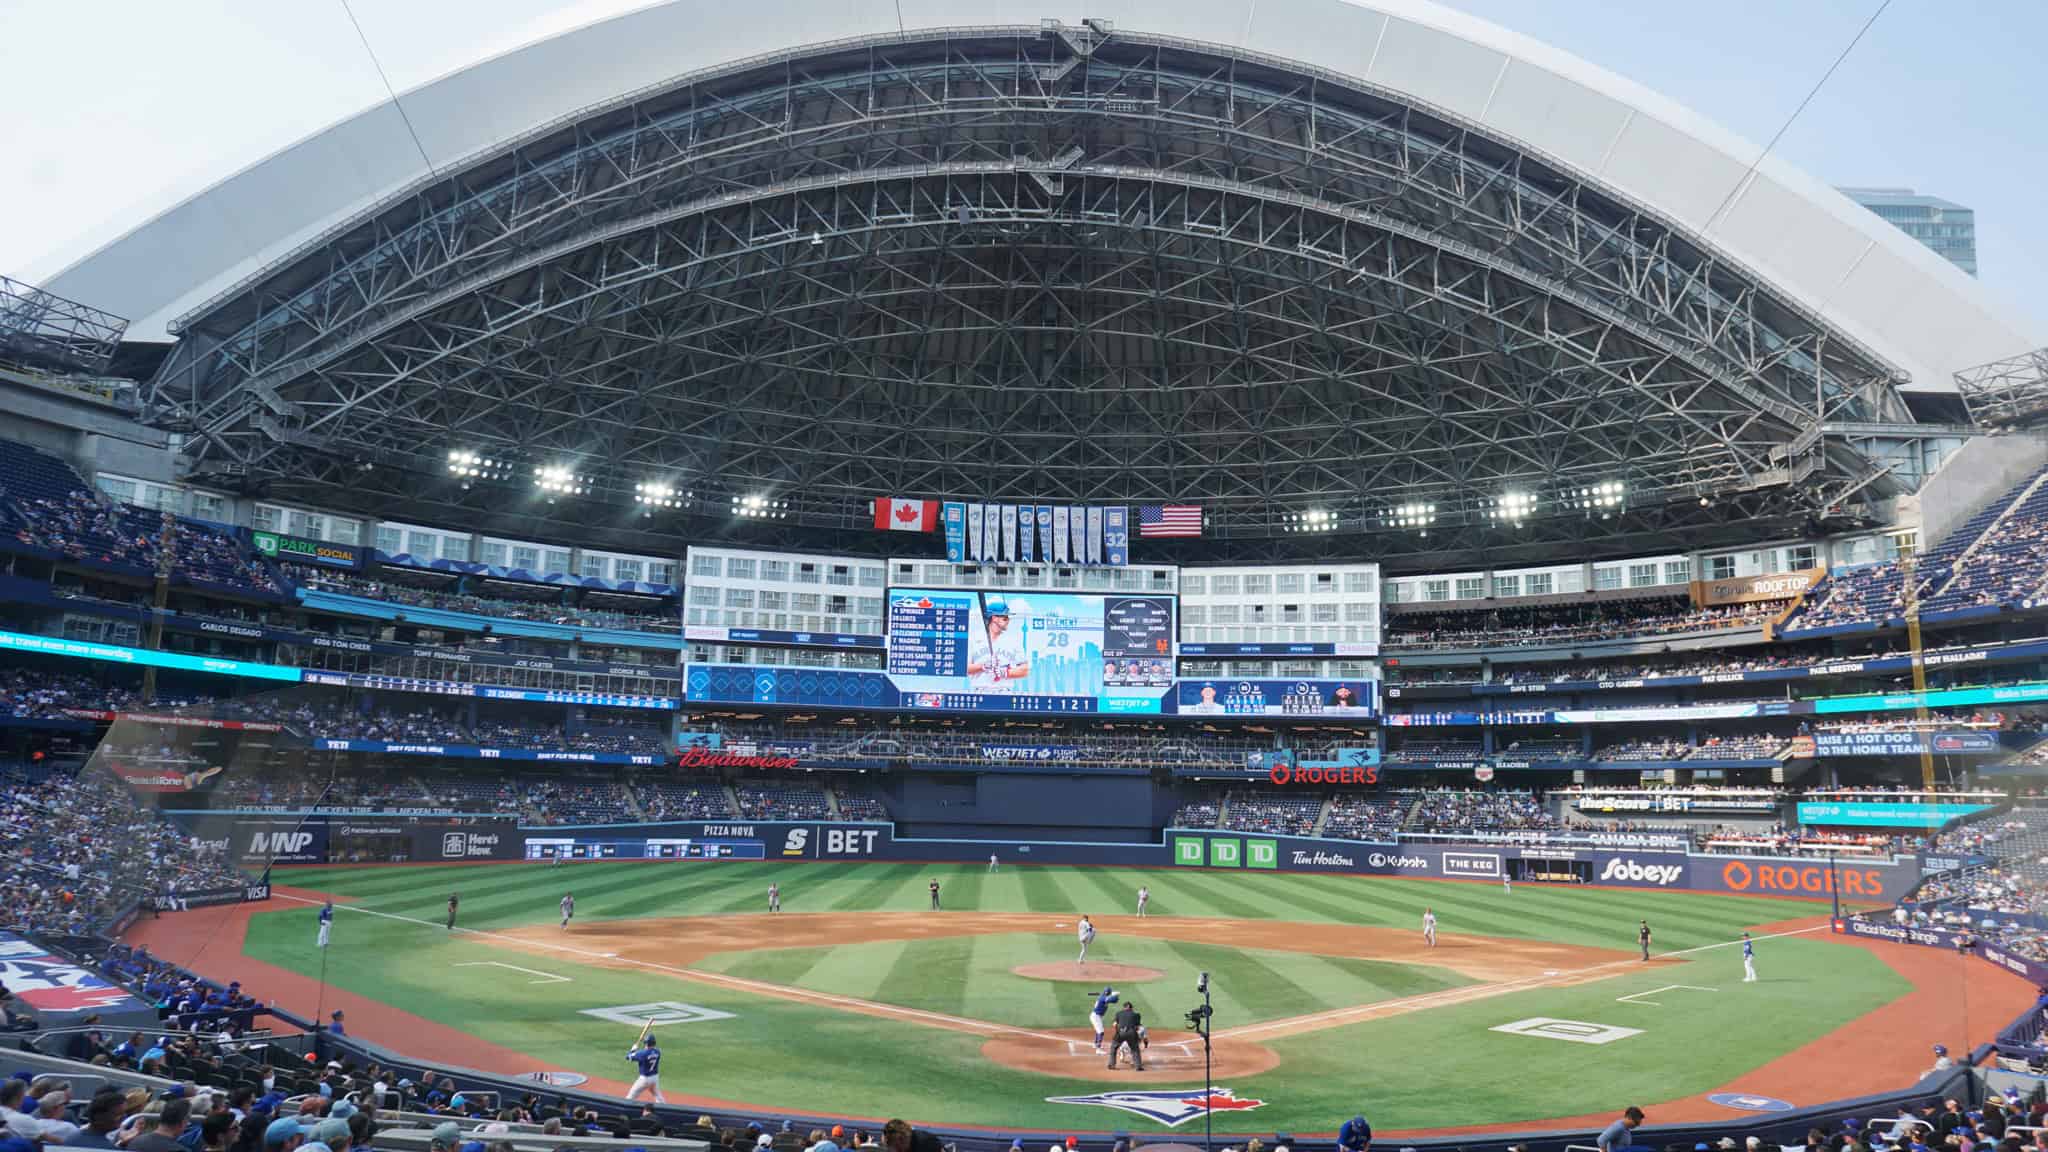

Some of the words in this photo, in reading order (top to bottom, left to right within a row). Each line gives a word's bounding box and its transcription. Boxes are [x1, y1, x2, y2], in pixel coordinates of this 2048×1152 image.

[255, 535, 277, 552] TD
[280, 538, 317, 554] PARK
[1105, 532, 1126, 548] 32
[317, 547, 353, 560] SOCIAL
[1754, 576, 1809, 594] ROOFTOP
[200, 621, 228, 634] CARLOS
[229, 624, 262, 637] DELGADO
[332, 640, 348, 648] TOM
[349, 642, 372, 651] CHEEK
[1047, 632, 1069, 647] 28
[413, 649, 432, 658] TONY
[433, 650, 471, 662] FERNANDEZ
[1925, 655, 1942, 665] ROY
[1943, 651, 1987, 663] HALLADAY
[514, 659, 527, 667] JOE
[529, 660, 553, 669] CARTER
[1809, 664, 1827, 675] PAUL
[1829, 663, 1864, 674] BEESTON
[1616, 680, 1643, 688] GASTON
[1702, 675, 1715, 683] PAT
[1716, 673, 1744, 682] GILLICK
[1061, 699, 1065, 710] 1
[1071, 699, 1078, 710] 2
[1084, 699, 1088, 710] 1
[1817, 734, 1842, 745] RAISE
[1845, 734, 1856, 744] A
[1858, 734, 1880, 744] HOT
[1885, 733, 1912, 743] DOG
[327, 740, 349, 750] YETI
[480, 749, 500, 758] YETI
[632, 756, 652, 764] YETI
[982, 747, 1036, 759] WESTJET
[1817, 745, 1828, 755] TO
[1829, 745, 1848, 755] THE
[1850, 744, 1888, 754] HOME
[1891, 743, 1928, 754] TEAM!
[675, 747, 800, 769] Budweiser
[1295, 767, 1377, 783] ROGERS
[1579, 797, 1649, 810] theScore
[1663, 798, 1691, 810] BET
[315, 806, 350, 814] NEXEN
[399, 807, 431, 815] NEXEN
[432, 807, 454, 815] TIRE
[704, 825, 729, 836] PIZZA
[730, 826, 754, 837] NOVA
[250, 832, 313, 853] MNP
[467, 833, 499, 845] Here's
[785, 828, 809, 850] S
[827, 829, 879, 853] BET
[1588, 834, 1648, 847] CANADA
[467, 845, 492, 856] How.
[1178, 842, 1200, 860] TD
[1214, 843, 1237, 862] TD
[1250, 844, 1274, 863] TD
[1292, 850, 1312, 865] Tim
[1313, 851, 1353, 866] Hortons
[1387, 856, 1428, 868] Kubota
[1450, 859, 1469, 869] THE
[1472, 860, 1493, 870] KEG
[1601, 857, 1683, 885] Sobeys
[1758, 866, 1883, 896] ROGERS
[247, 886, 268, 899] VISA
[1853, 922, 1877, 934] Official
[649, 1058, 657, 1072] 7
